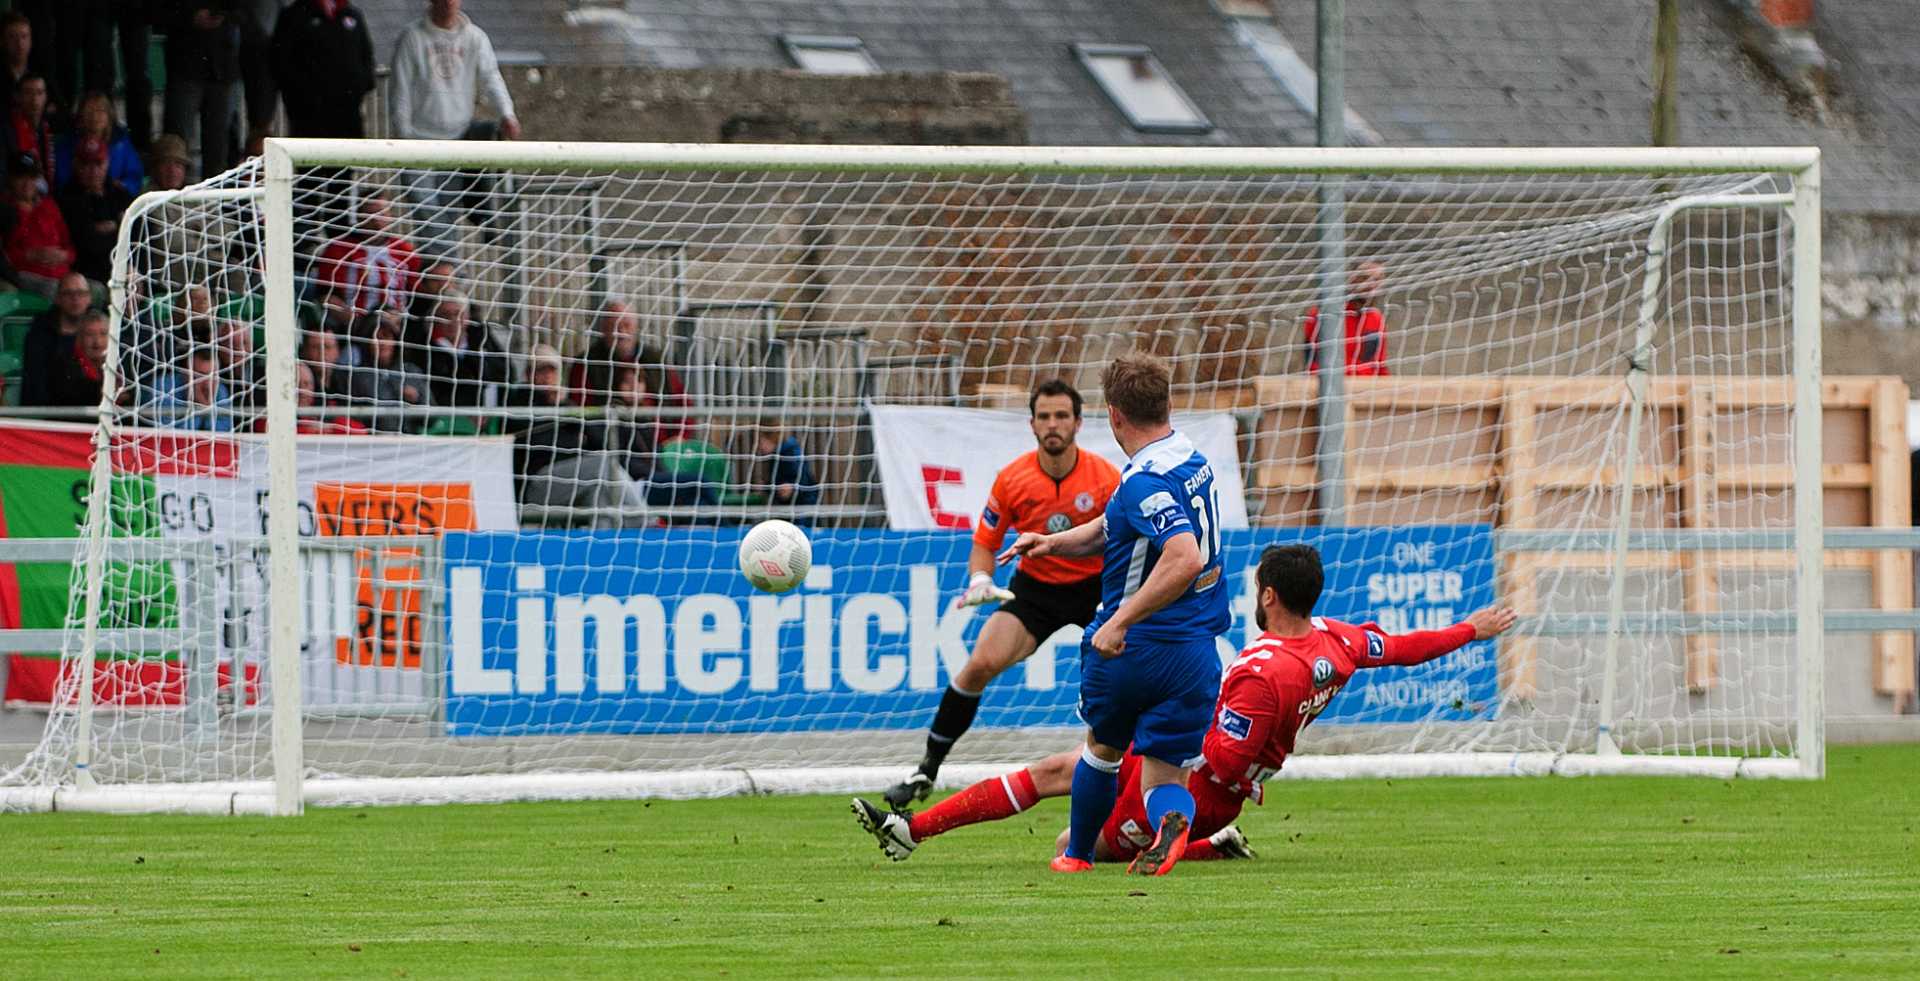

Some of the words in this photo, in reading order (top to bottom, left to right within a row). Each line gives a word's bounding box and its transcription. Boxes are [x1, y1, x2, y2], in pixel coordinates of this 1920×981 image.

[1393, 542, 1436, 566] ONE
[1368, 571, 1462, 602] SUPER
[450, 564, 976, 695] Limerick
[1378, 607, 1454, 635] BLUE
